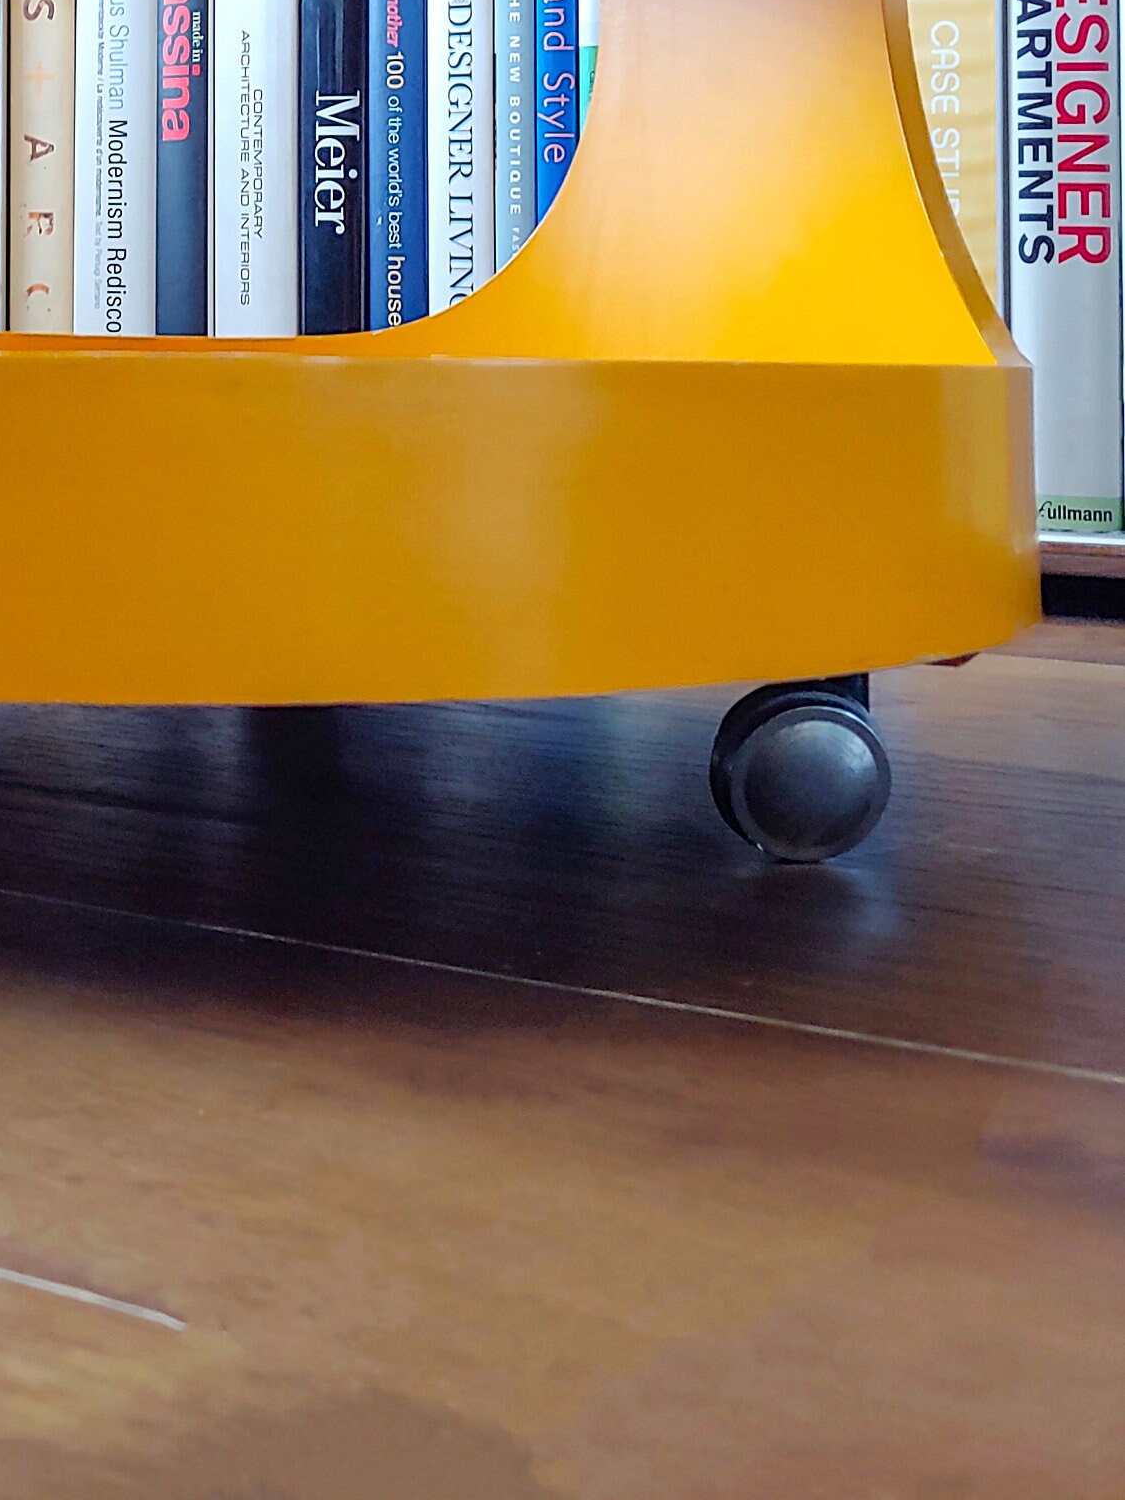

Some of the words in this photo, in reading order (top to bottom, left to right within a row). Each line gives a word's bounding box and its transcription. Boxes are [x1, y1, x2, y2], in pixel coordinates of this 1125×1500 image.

[108, 25, 130, 110] Shulman
[192, 11, 204, 48] made
[192, 49, 203, 63] in
[386, 50, 405, 90] 100
[509, 35, 521, 83] NEW
[930, 19, 961, 115] CASE
[239, 29, 251, 163] ARCHITECTURE
[387, 95, 403, 113] of
[387, 116, 403, 144] the
[447, 0, 474, 185] DESIGNER
[537, 72, 576, 164] Style
[107, 119, 128, 240] Modernism
[239, 168, 250, 207] AND
[253, 88, 263, 240] CONTEMPORARY
[315, 90, 361, 235] Meier
[388, 148, 403, 208] world's
[509, 96, 522, 215] BOUTIQUE
[239, 213, 250, 306] INTERIORS
[388, 212, 403, 249] best
[510, 227, 521, 256] FAS
[105, 248, 127, 333] Redisco
